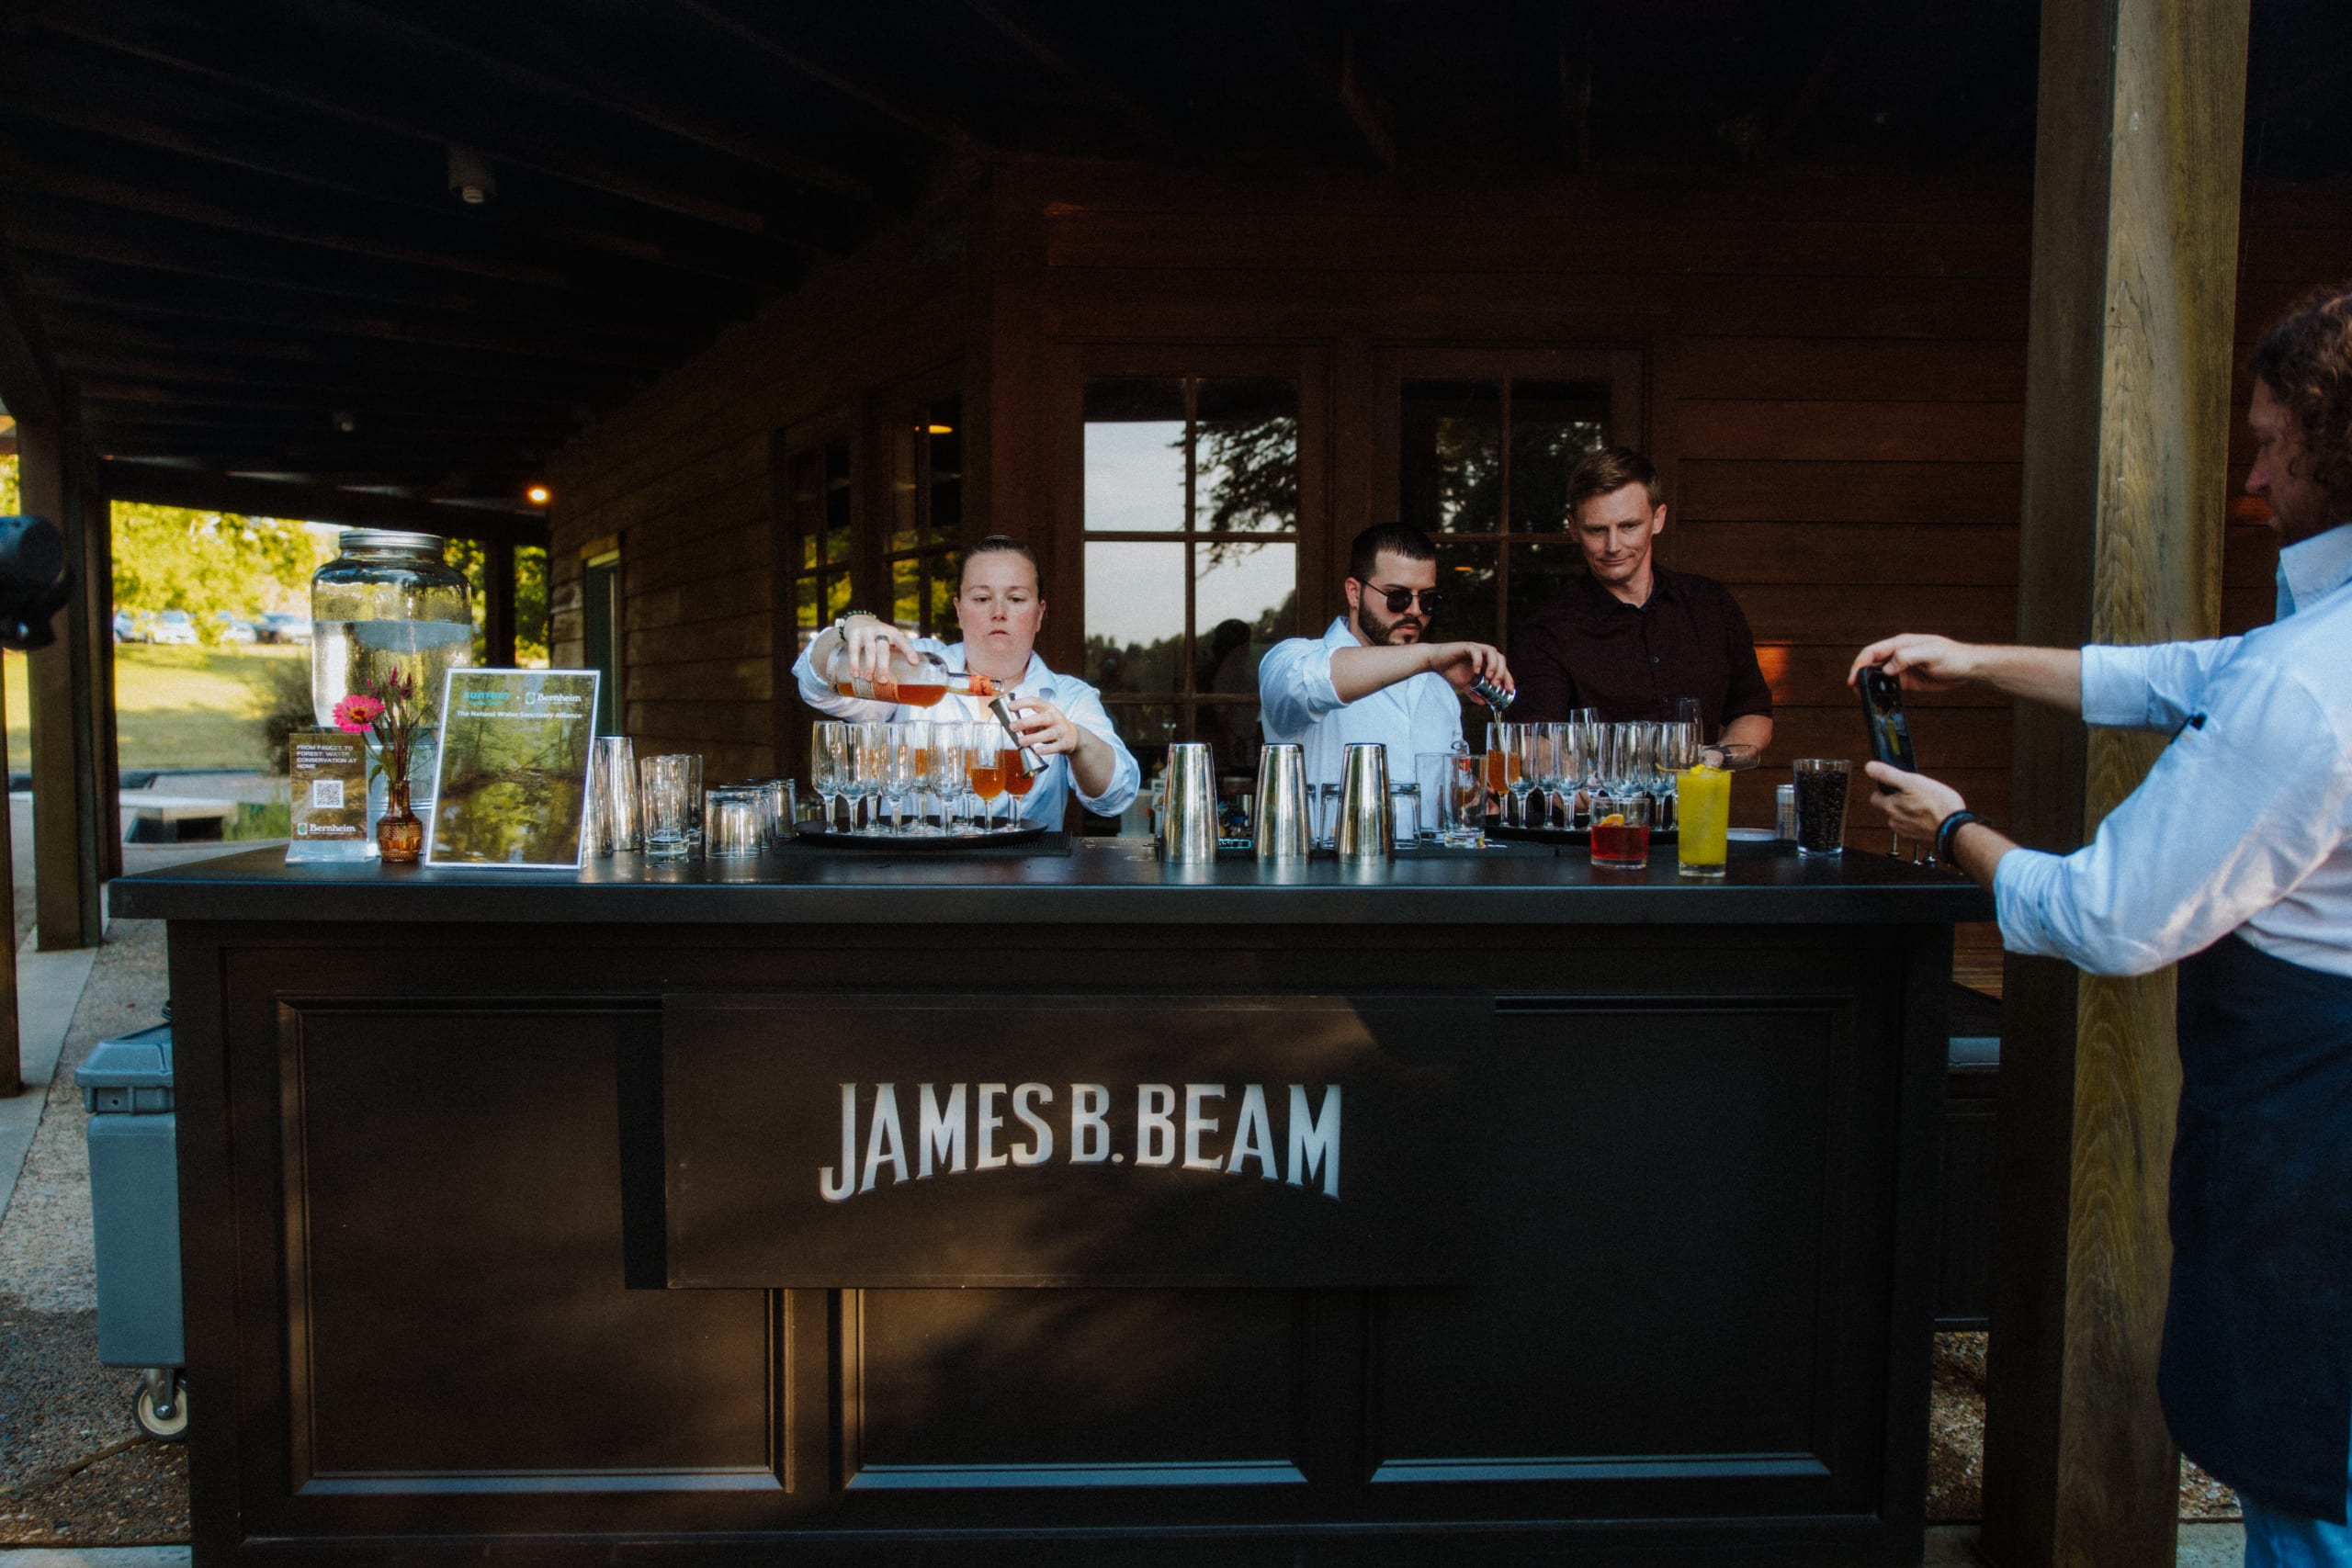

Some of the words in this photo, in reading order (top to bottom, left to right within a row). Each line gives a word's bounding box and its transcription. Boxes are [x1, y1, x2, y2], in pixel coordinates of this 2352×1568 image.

[537, 693, 582, 702] Bernheim
[519, 712, 554, 720] Sanctuary
[309, 823, 356, 832] Bernheim
[820, 1082, 1054, 1202] JAMES
[1069, 1082, 1125, 1165] B.
[1135, 1083, 1341, 1201] BEAM
